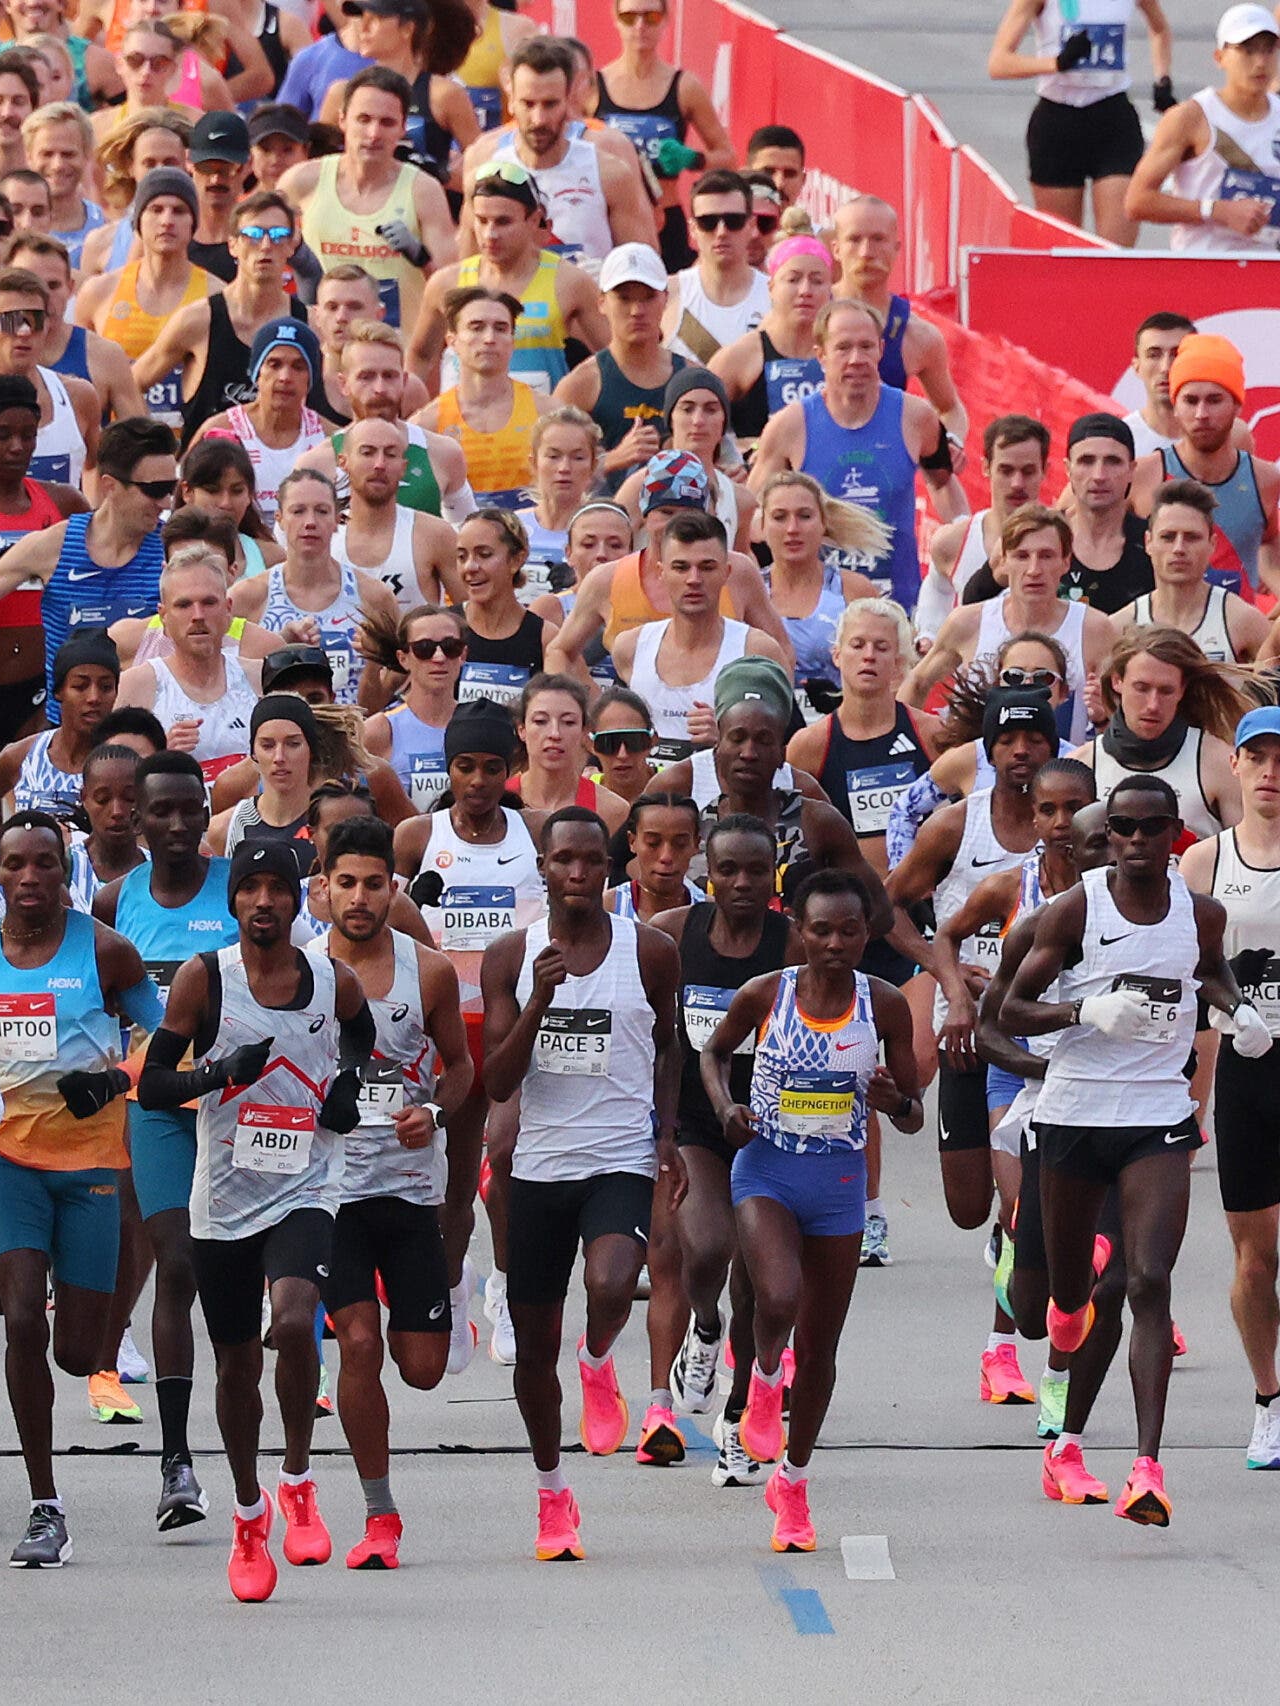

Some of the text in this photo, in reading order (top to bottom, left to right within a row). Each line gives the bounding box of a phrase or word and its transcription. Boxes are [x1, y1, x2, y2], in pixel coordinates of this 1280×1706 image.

[144, 383, 178, 404] 81
[1224, 884, 1252, 896] ZAP
[188, 920, 223, 931] HOKA
[445, 912, 513, 929] DIBABA
[47, 977, 82, 989] HOKA
[1167, 1006, 1177, 1022] 6
[540, 1033, 605, 1053] PACE 3
[386, 1087, 397, 1103] 7
[250, 1131, 298, 1151] ABDI
